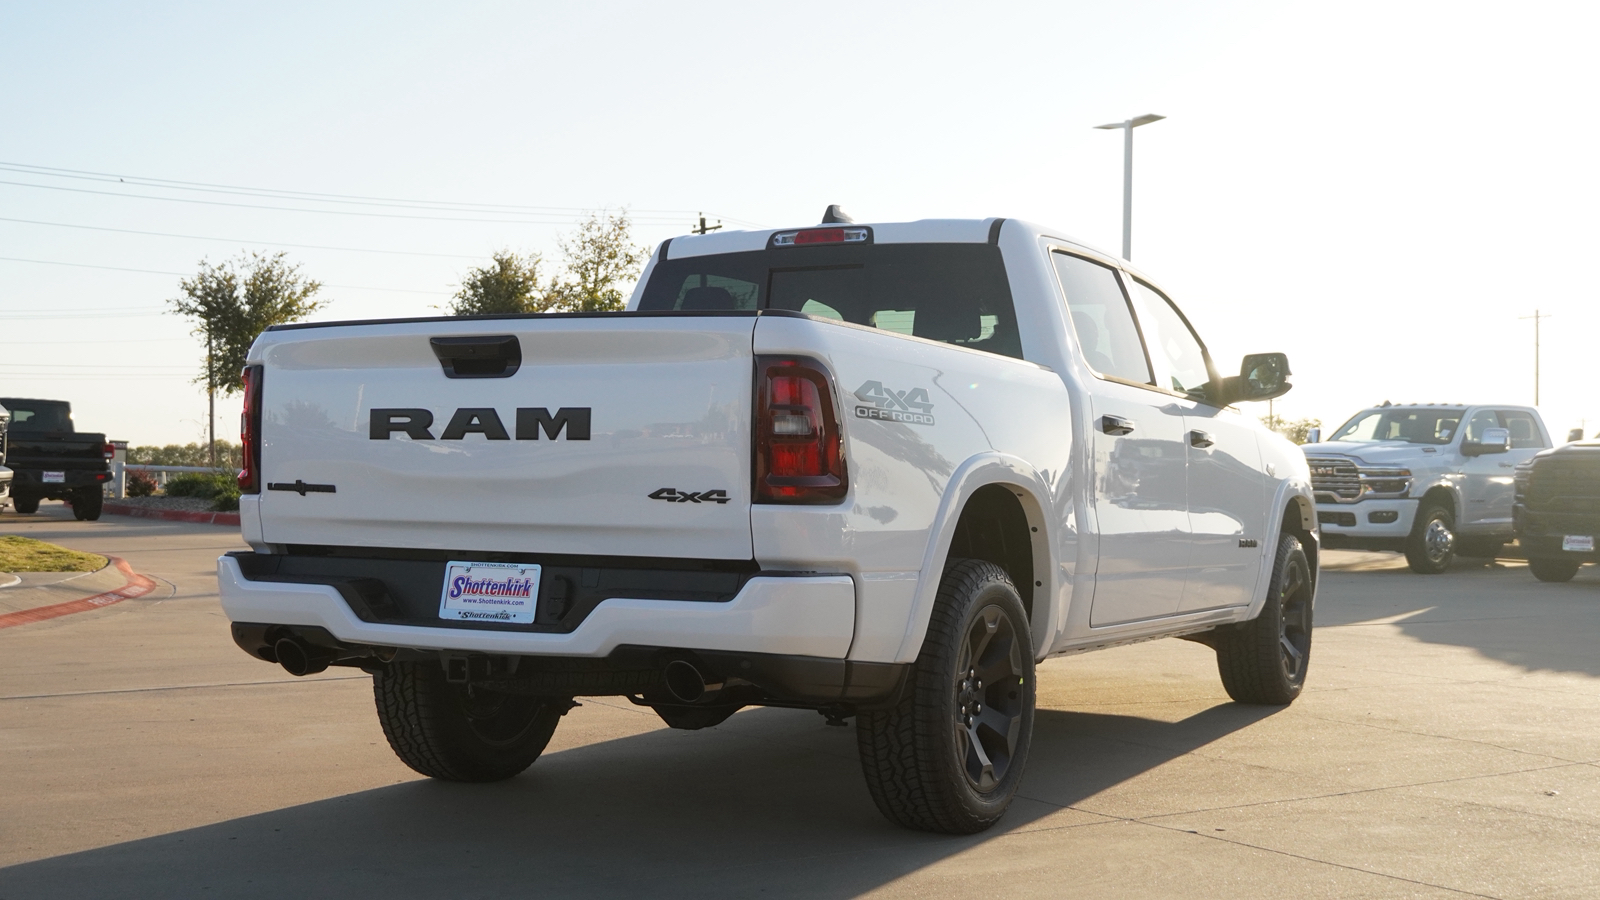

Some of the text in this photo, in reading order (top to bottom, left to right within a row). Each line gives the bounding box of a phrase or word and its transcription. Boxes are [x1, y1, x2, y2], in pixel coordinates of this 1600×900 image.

[369, 407, 591, 440] RAM
[856, 408, 934, 424] OFF ROAD
[449, 575, 534, 599] Shottenkirk
[462, 598, 525, 606] www.Shottenkirk.com
